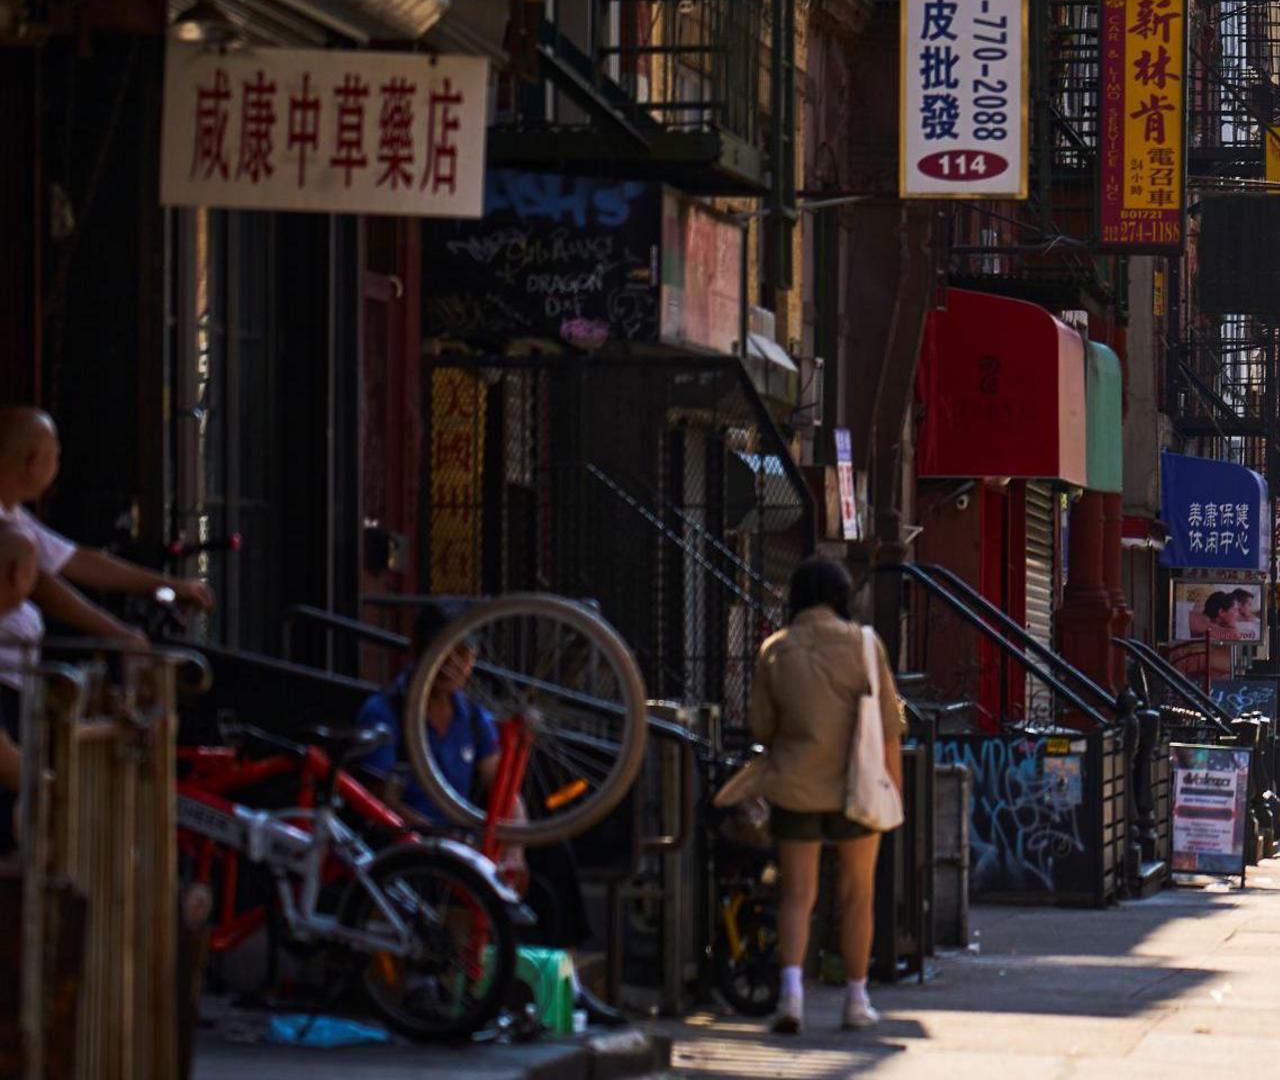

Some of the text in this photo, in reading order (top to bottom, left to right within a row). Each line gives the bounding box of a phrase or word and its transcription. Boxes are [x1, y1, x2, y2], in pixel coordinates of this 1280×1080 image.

[938, 154, 987, 175] 114
[1147, 147, 1176, 207] 電召車
[1120, 221, 1180, 242] 274-1188
[1187, 501, 1250, 530] 美康保健
